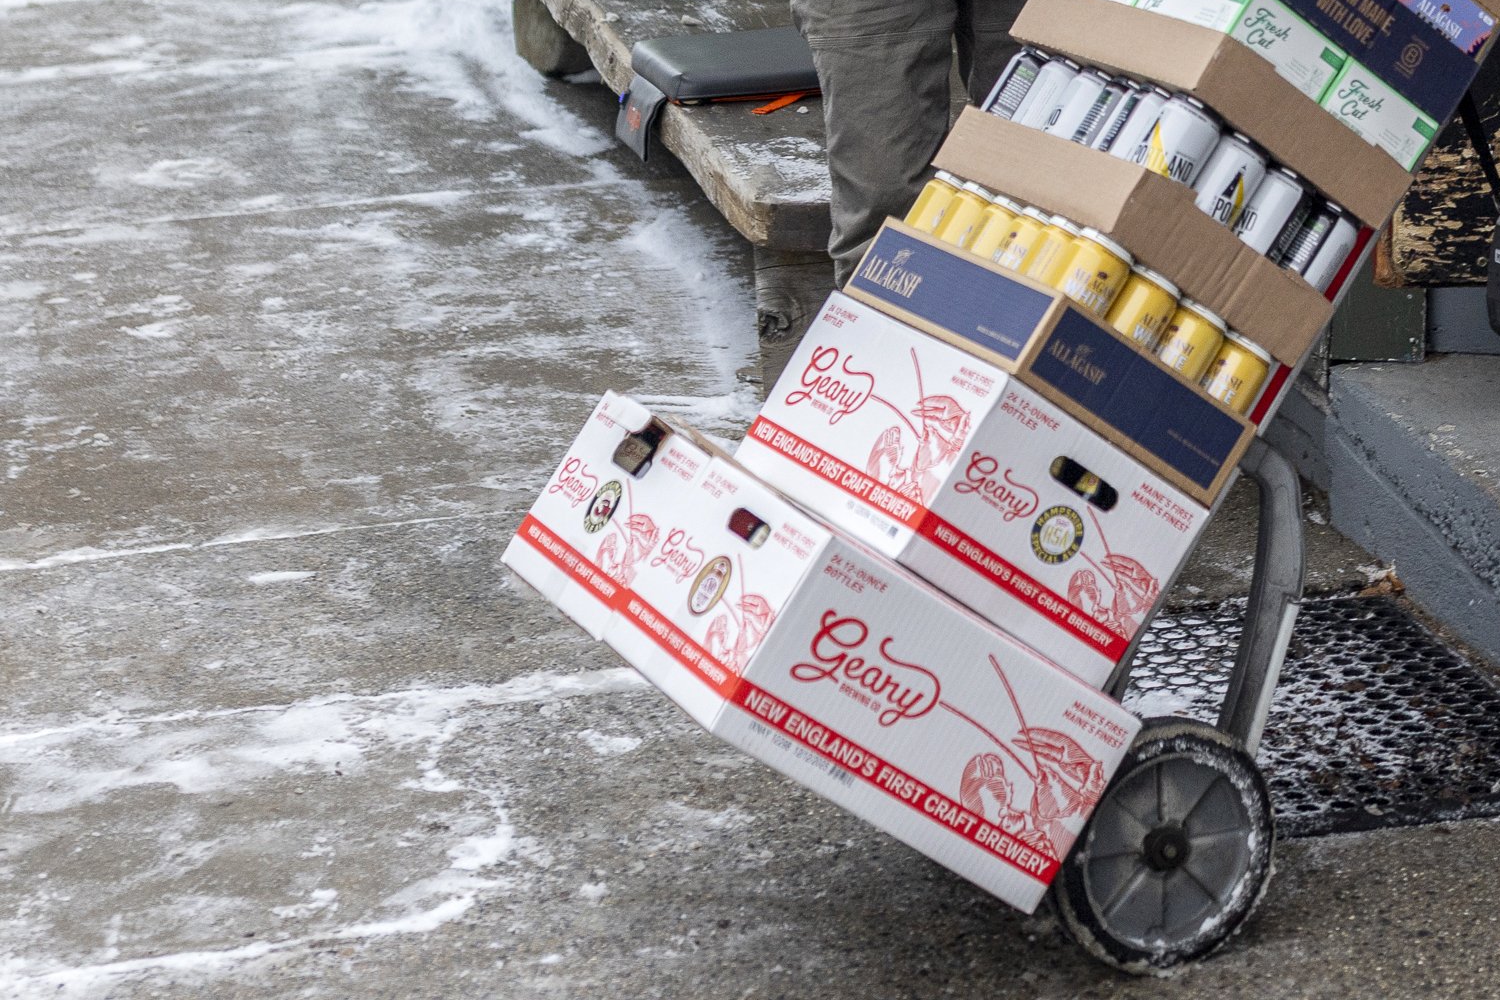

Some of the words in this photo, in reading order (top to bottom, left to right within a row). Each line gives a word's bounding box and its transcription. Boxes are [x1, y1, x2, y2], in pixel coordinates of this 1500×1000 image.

[1244, 8, 1292, 42] Fresh
[1247, 29, 1276, 50] Cut
[1337, 79, 1385, 113] Fresh
[1340, 101, 1370, 121] Cut
[860, 254, 923, 299] ALLAGASH
[1048, 339, 1108, 385] ALLAGASH
[785, 346, 875, 425] Geary
[1001, 402, 1039, 431] BOTTLES
[1006, 392, 1018, 403] 24
[1019, 400, 1061, 432] 12-OUNCE
[548, 456, 599, 509] Geary
[754, 420, 776, 444] NEW
[773, 431, 819, 468] ENGLAND'S
[817, 454, 847, 482] FIRST
[841, 466, 873, 496] CRAFT
[868, 484, 917, 521] BREWERY
[954, 451, 1039, 522] Geary
[1131, 490, 1162, 518] MAINE'S
[1161, 510, 1190, 533] FINEST
[1140, 482, 1174, 508] MAINE'S
[1036, 506, 1083, 537] HAMPSHIRE
[528, 524, 541, 538] NEW
[537, 532, 565, 560] ENGLAND'S
[562, 552, 577, 570] FIRST
[574, 562, 593, 581] CRAFT
[589, 573, 617, 598] BREWERY
[650, 528, 704, 585] Geary
[1031, 533, 1059, 564] SPECIAL
[823, 566, 865, 594] BOTTLES
[845, 562, 888, 594] 12-OUNCE
[935, 525, 960, 548] NEW
[957, 539, 1011, 582] ENGLAND'S
[1009, 574, 1039, 600] FIRST
[1037, 592, 1070, 620] CRAFT
[1067, 613, 1115, 648] BREWERY
[627, 601, 641, 616] NEW
[638, 608, 670, 640] ENGLAND'S
[667, 631, 684, 651] FIRST
[681, 641, 701, 665] CRAFT
[698, 655, 728, 686] BREWERY
[789, 609, 941, 727] Geary
[839, 683, 871, 709] BREWING
[1072, 700, 1106, 727] MAINE'S
[1062, 709, 1095, 736] MAINE'S
[1095, 726, 1125, 750] FINEST
[744, 689, 785, 723] NEW
[784, 711, 878, 777] ENGLAND'S
[876, 766, 926, 805] FIRST
[923, 791, 978, 833] CRAFT
[974, 825, 1051, 877] BREWERY
